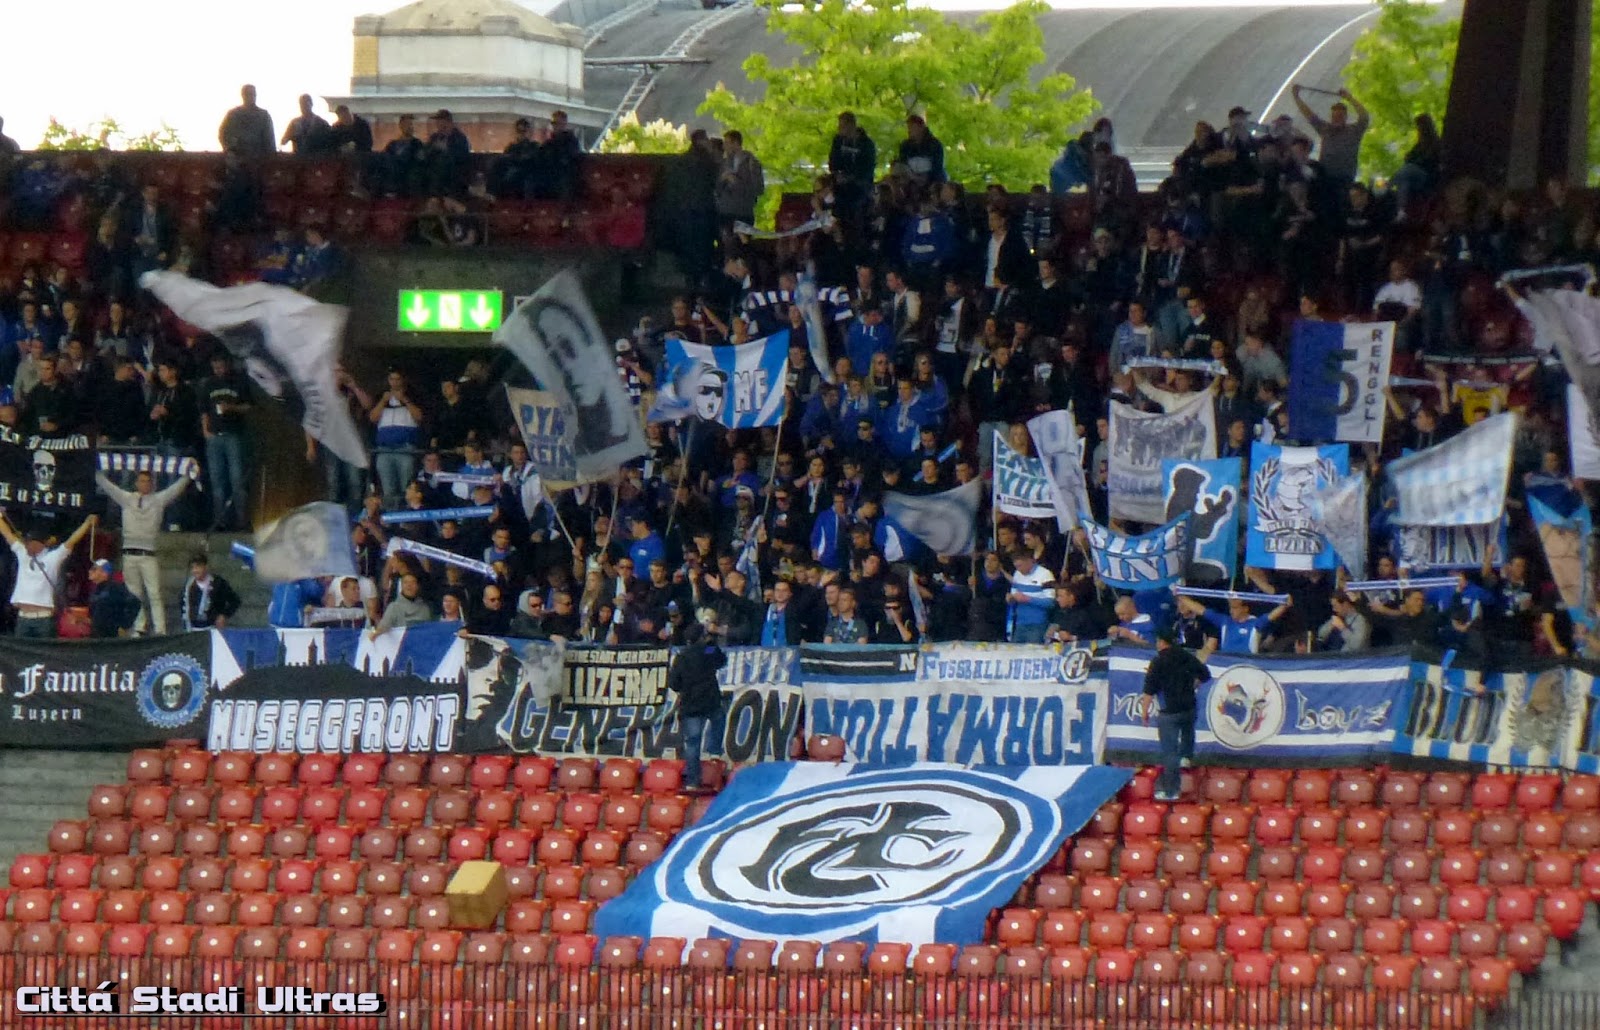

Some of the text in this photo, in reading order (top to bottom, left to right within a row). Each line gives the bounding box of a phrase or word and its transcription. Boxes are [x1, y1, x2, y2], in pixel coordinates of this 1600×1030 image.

[1364, 329, 1384, 437] RENGGLI
[0, 482, 82, 507] Luzern
[14, 663, 135, 699] Familia
[12, 704, 82, 723] Luzern
[208, 694, 459, 753] MUSEGGFRONT
